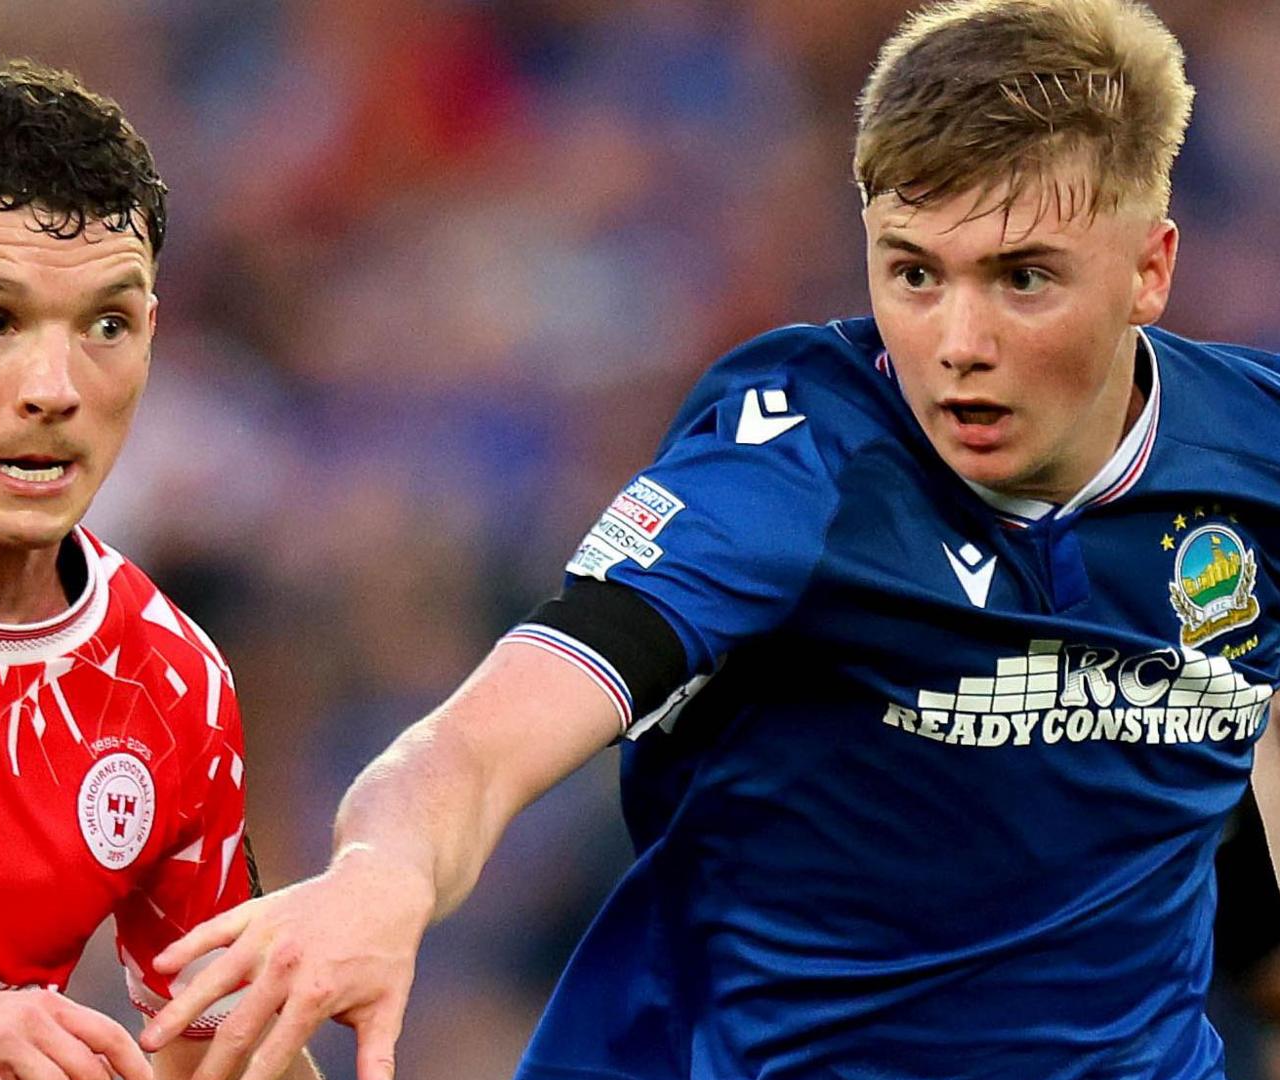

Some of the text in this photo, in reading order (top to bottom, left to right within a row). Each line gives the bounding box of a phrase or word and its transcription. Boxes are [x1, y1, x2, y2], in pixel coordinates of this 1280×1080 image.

[625, 481, 673, 514] SPORTS
[1059, 645, 1181, 707] RC
[882, 702, 1039, 747] READY
